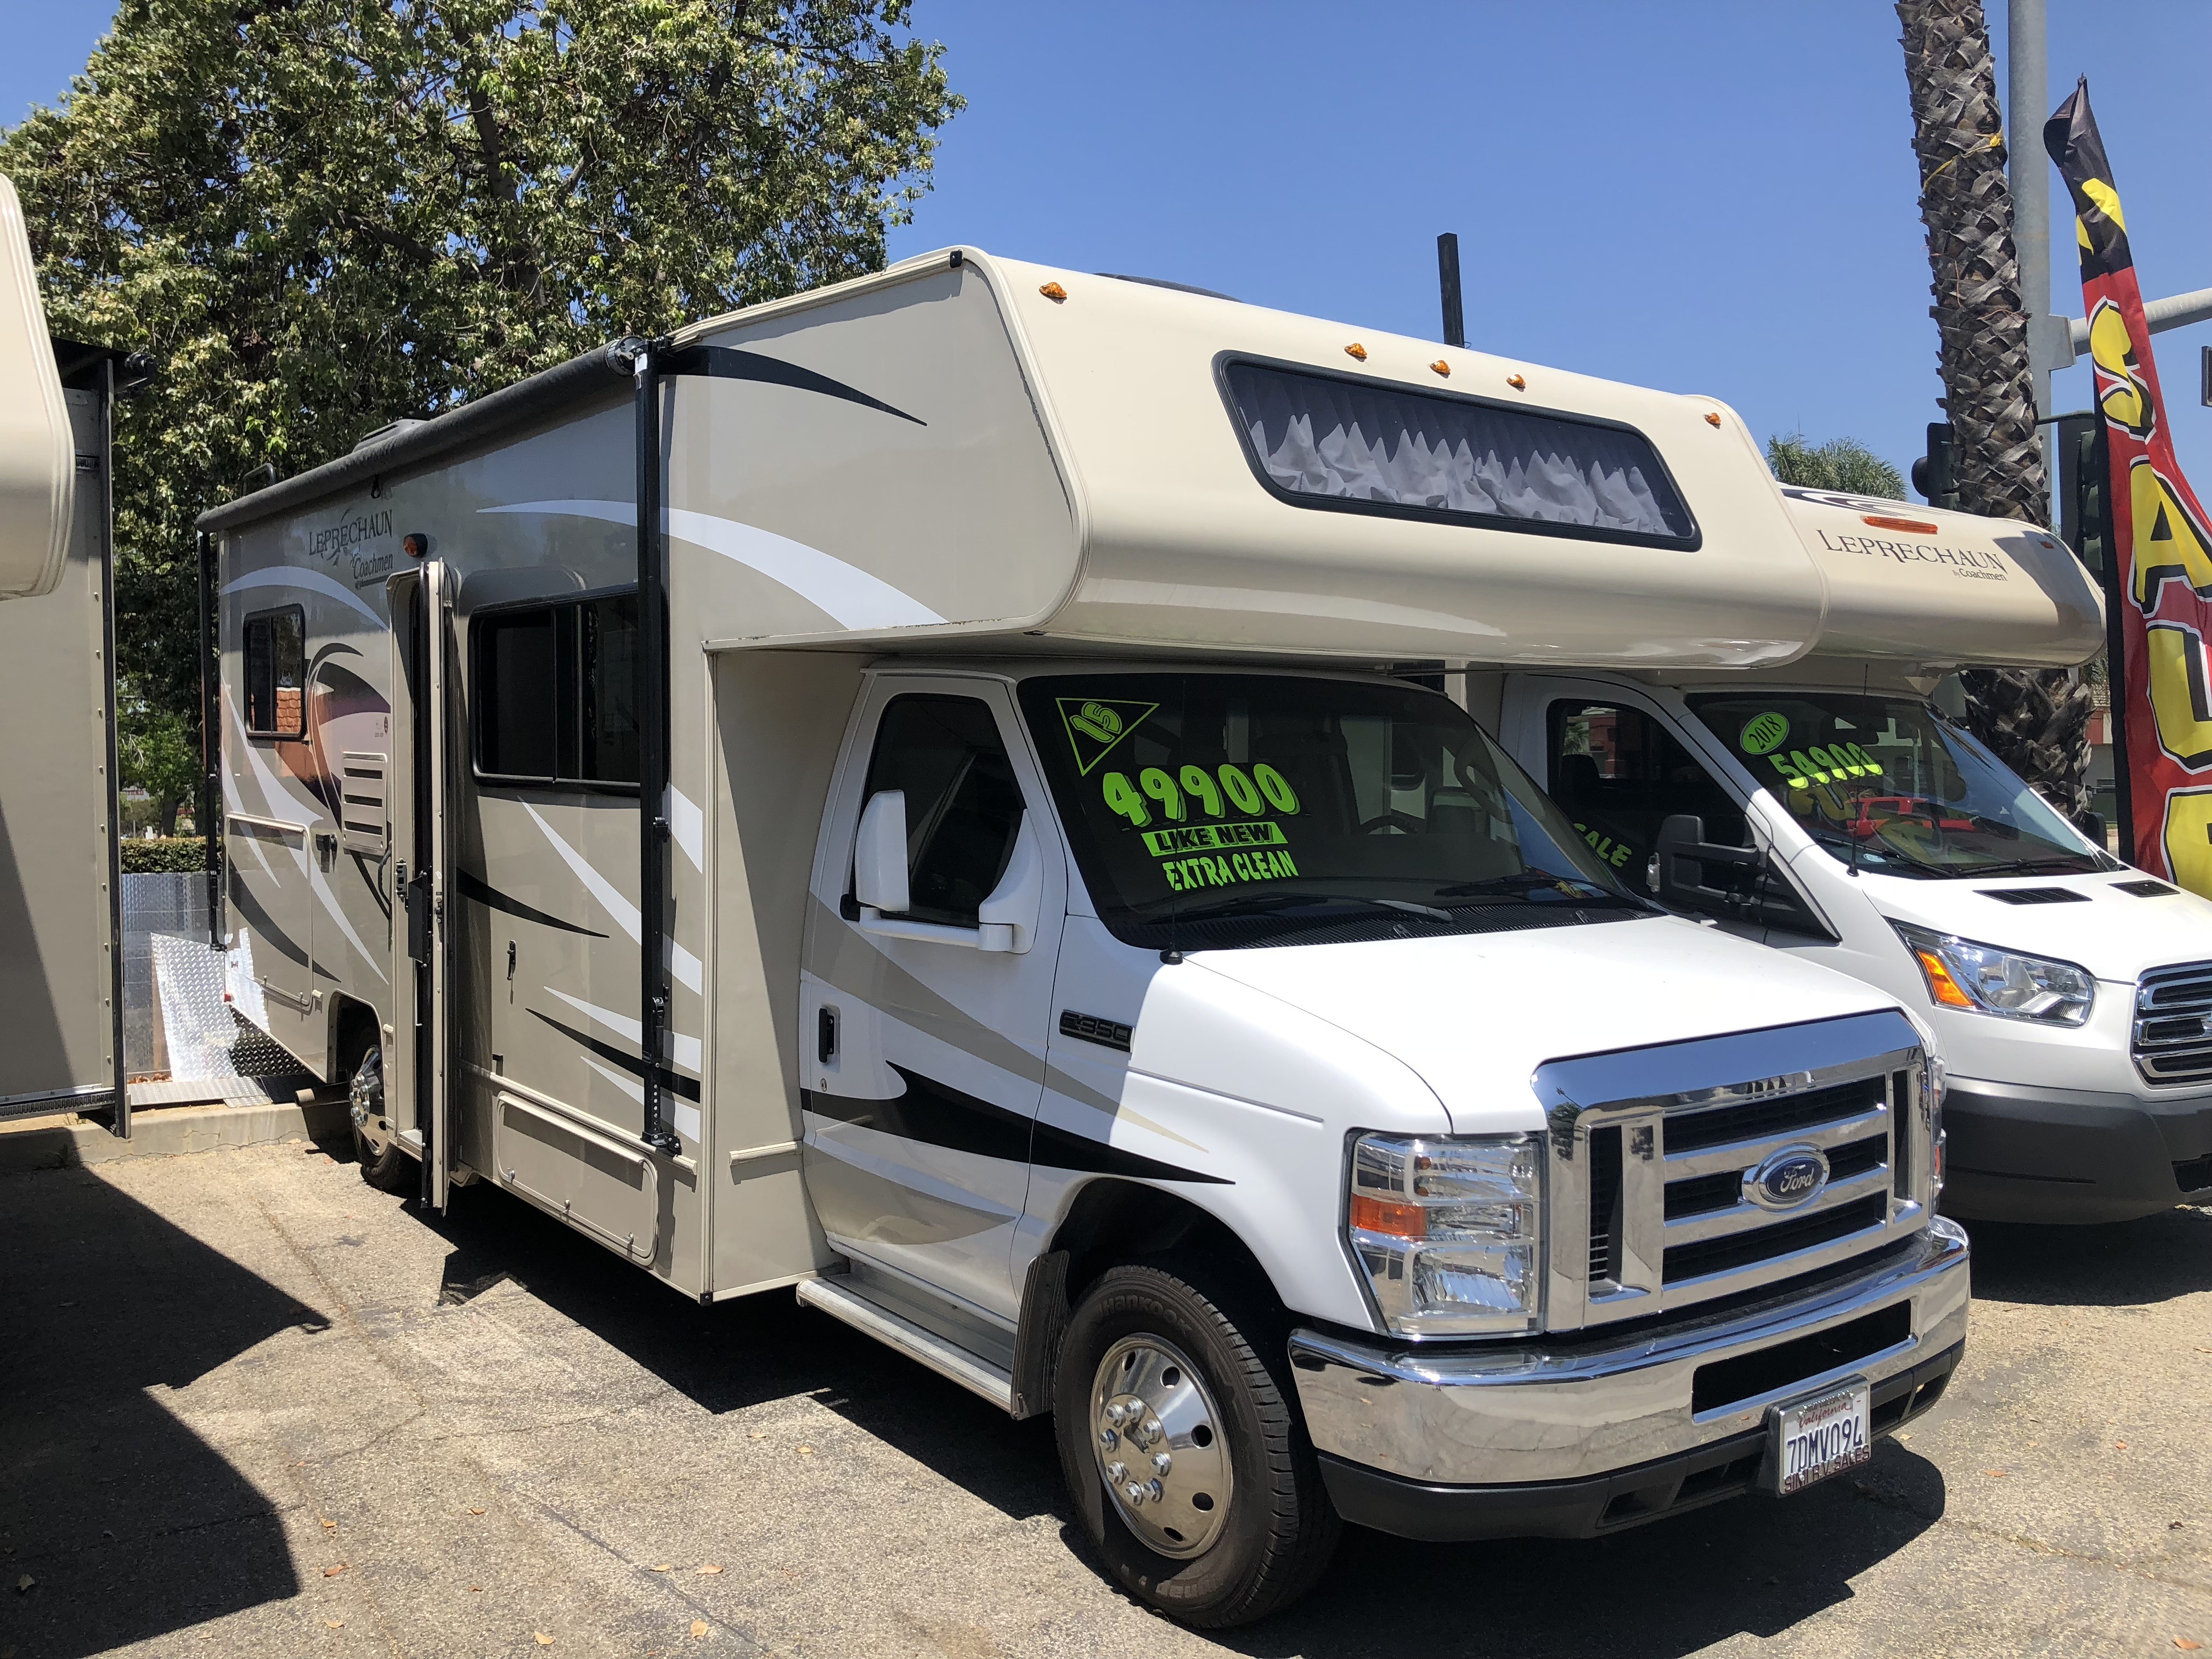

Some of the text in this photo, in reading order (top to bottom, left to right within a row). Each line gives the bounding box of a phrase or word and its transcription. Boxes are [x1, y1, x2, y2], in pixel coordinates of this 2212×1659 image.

[309, 509, 393, 556] LEPRECHAUN
[1816, 529, 2008, 574] LEPRECHAUN
[353, 552, 393, 579] Coachmen
[1959, 568, 2008, 582] Coachmen
[1748, 715, 1782, 751] 2018
[1768, 742, 1883, 789] 54900
[1102, 763, 1301, 828] 49900
[1154, 823, 1273, 853] LIKE NEW
[1162, 850, 1299, 891] EXTRA CLEAN
[1780, 1164, 1815, 1193] Ford
[1799, 1402, 1853, 1428] California
[1787, 1415, 1863, 1474] 7DMV094
